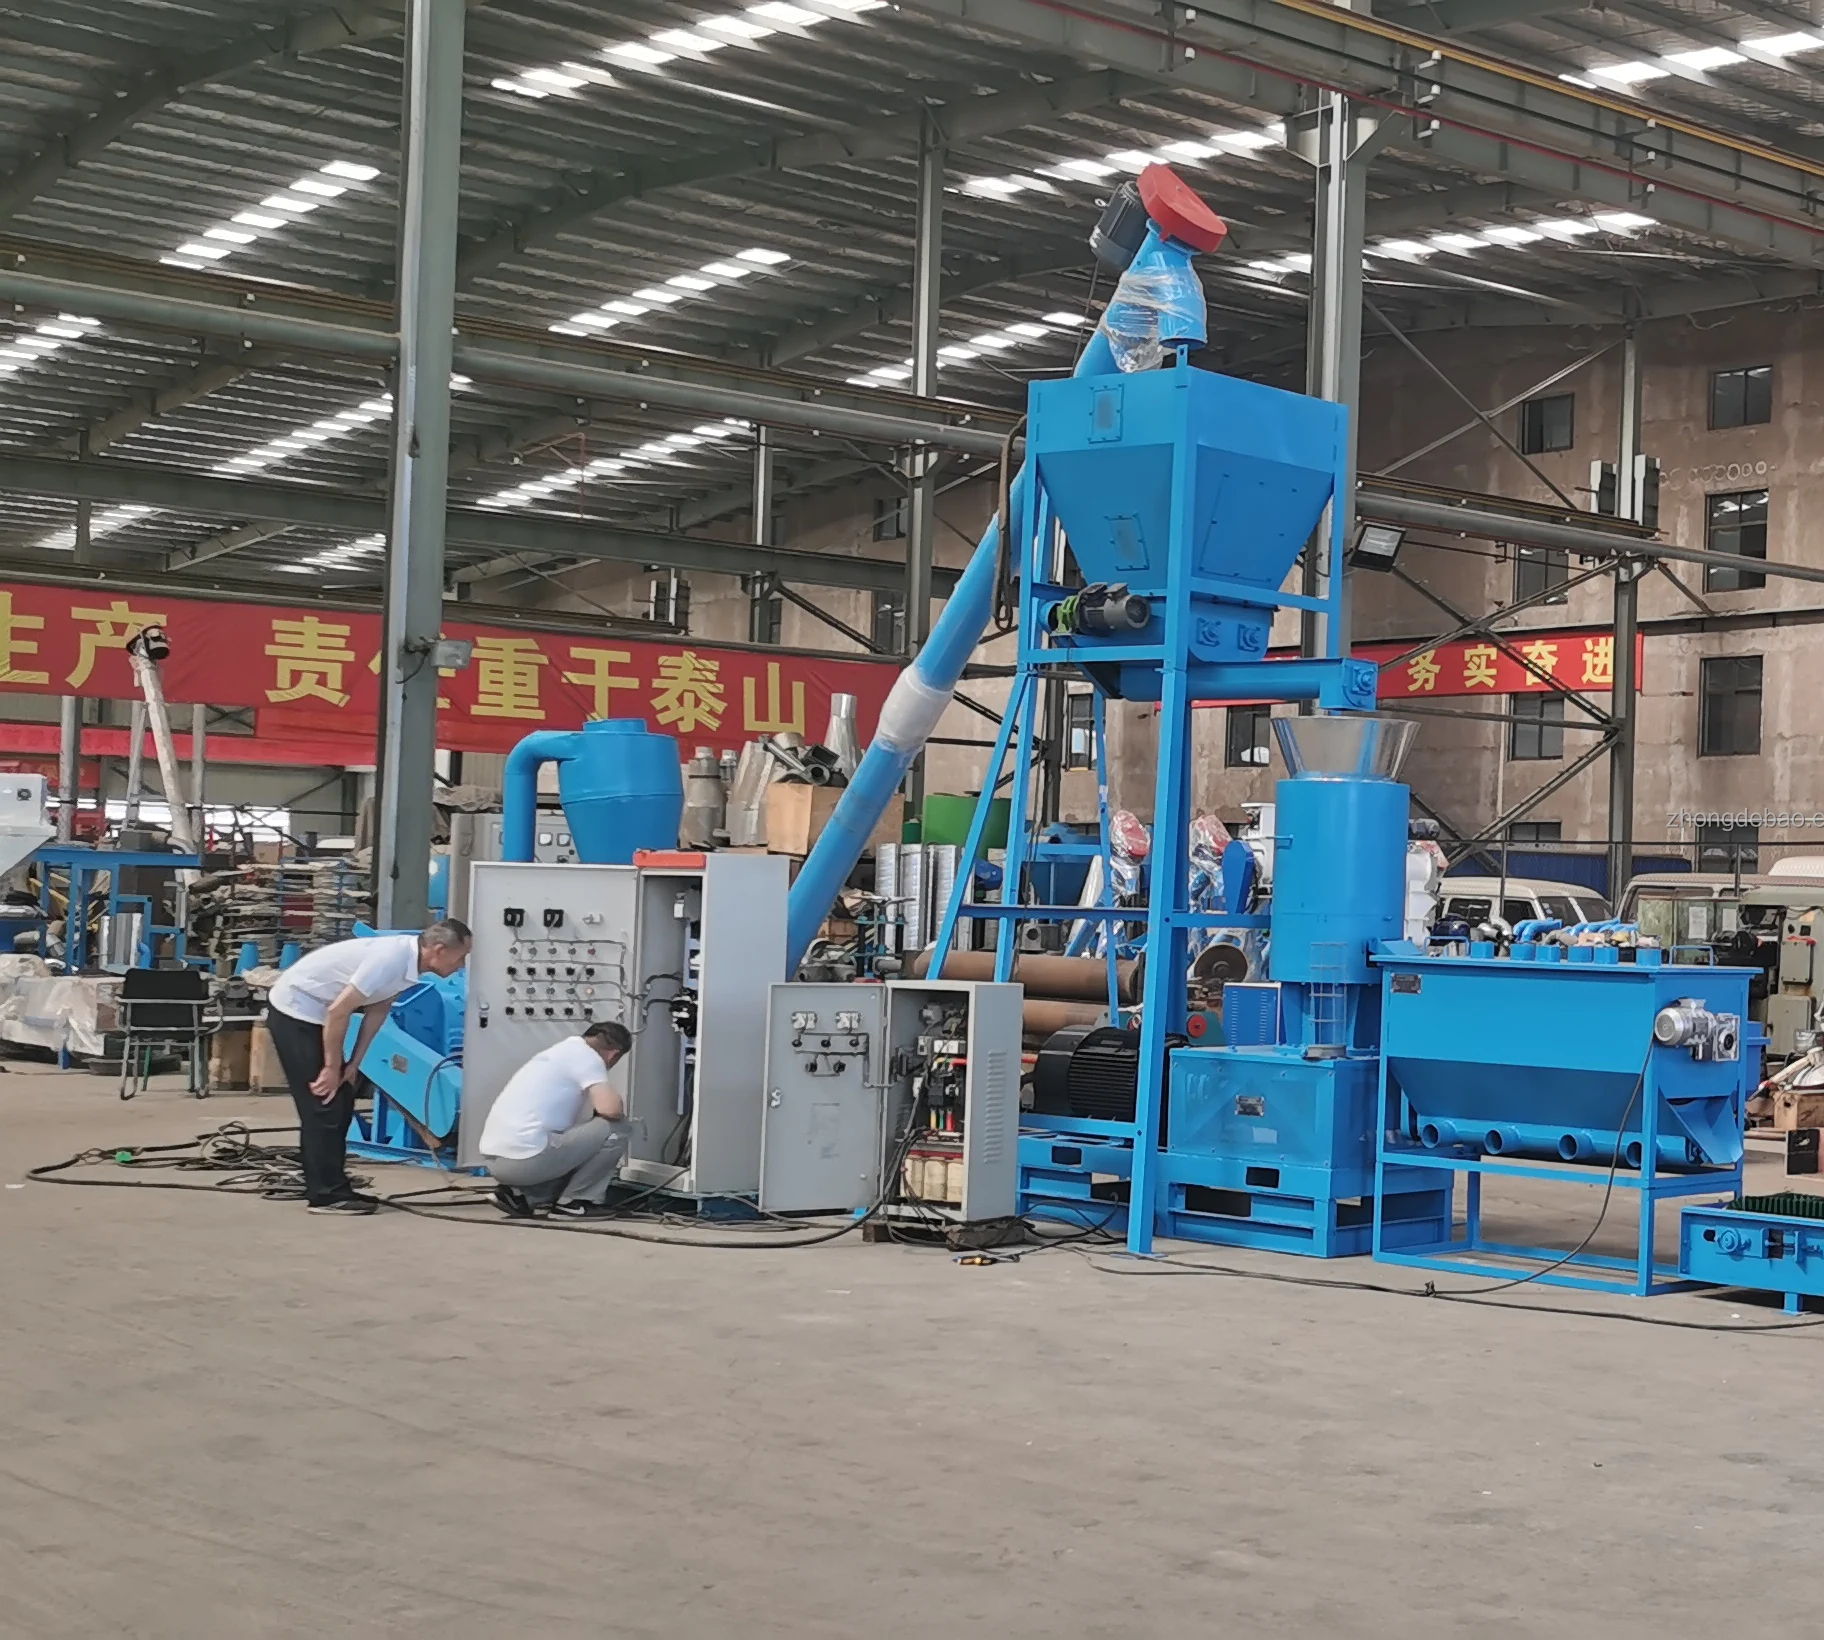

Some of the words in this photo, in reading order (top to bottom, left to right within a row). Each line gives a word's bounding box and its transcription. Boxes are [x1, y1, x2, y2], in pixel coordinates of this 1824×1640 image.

[265, 616, 806, 735] 责重于泰山
[1407, 637, 1614, 692] 务实奋进
